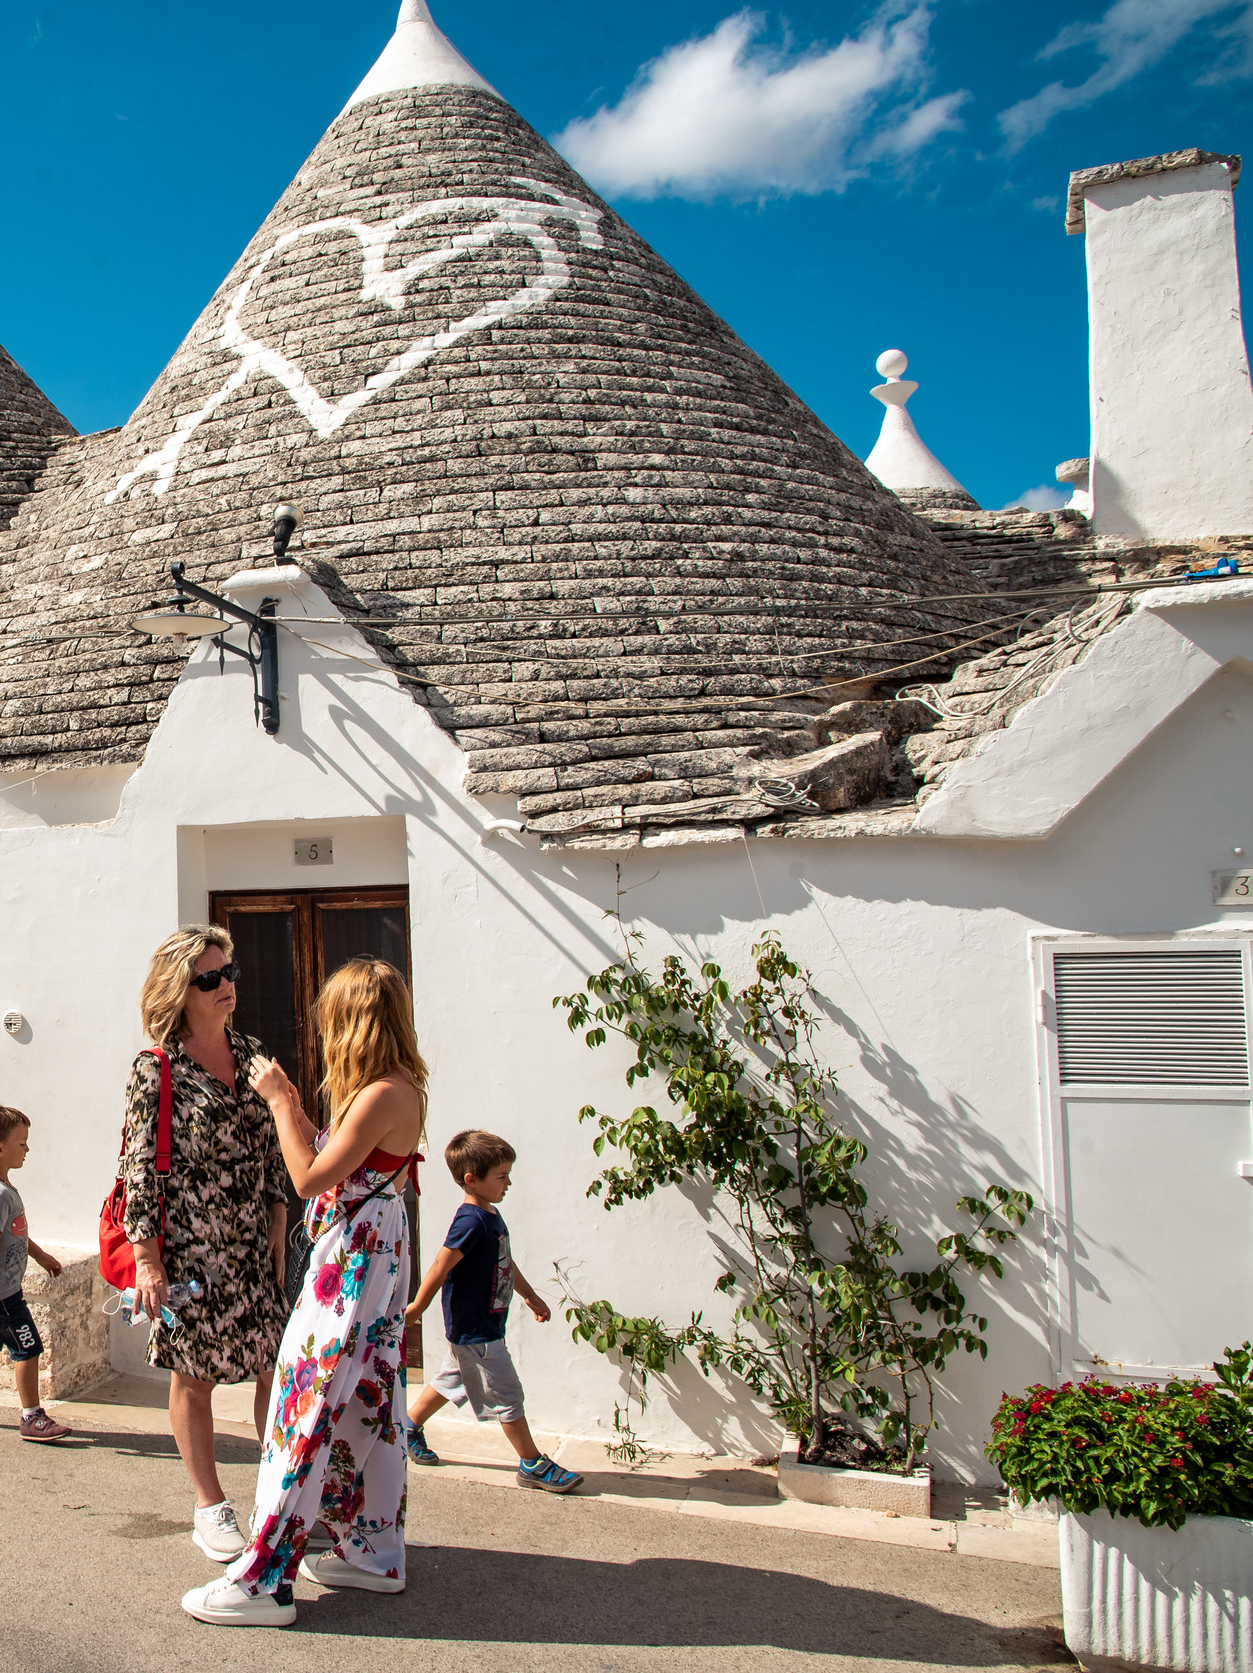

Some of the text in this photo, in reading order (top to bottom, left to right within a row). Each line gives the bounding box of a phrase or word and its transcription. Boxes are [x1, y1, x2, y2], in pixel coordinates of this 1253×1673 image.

[308, 844, 318, 860] 5
[1235, 876, 1250, 896] 3
[16, 1324, 35, 1348] 983
